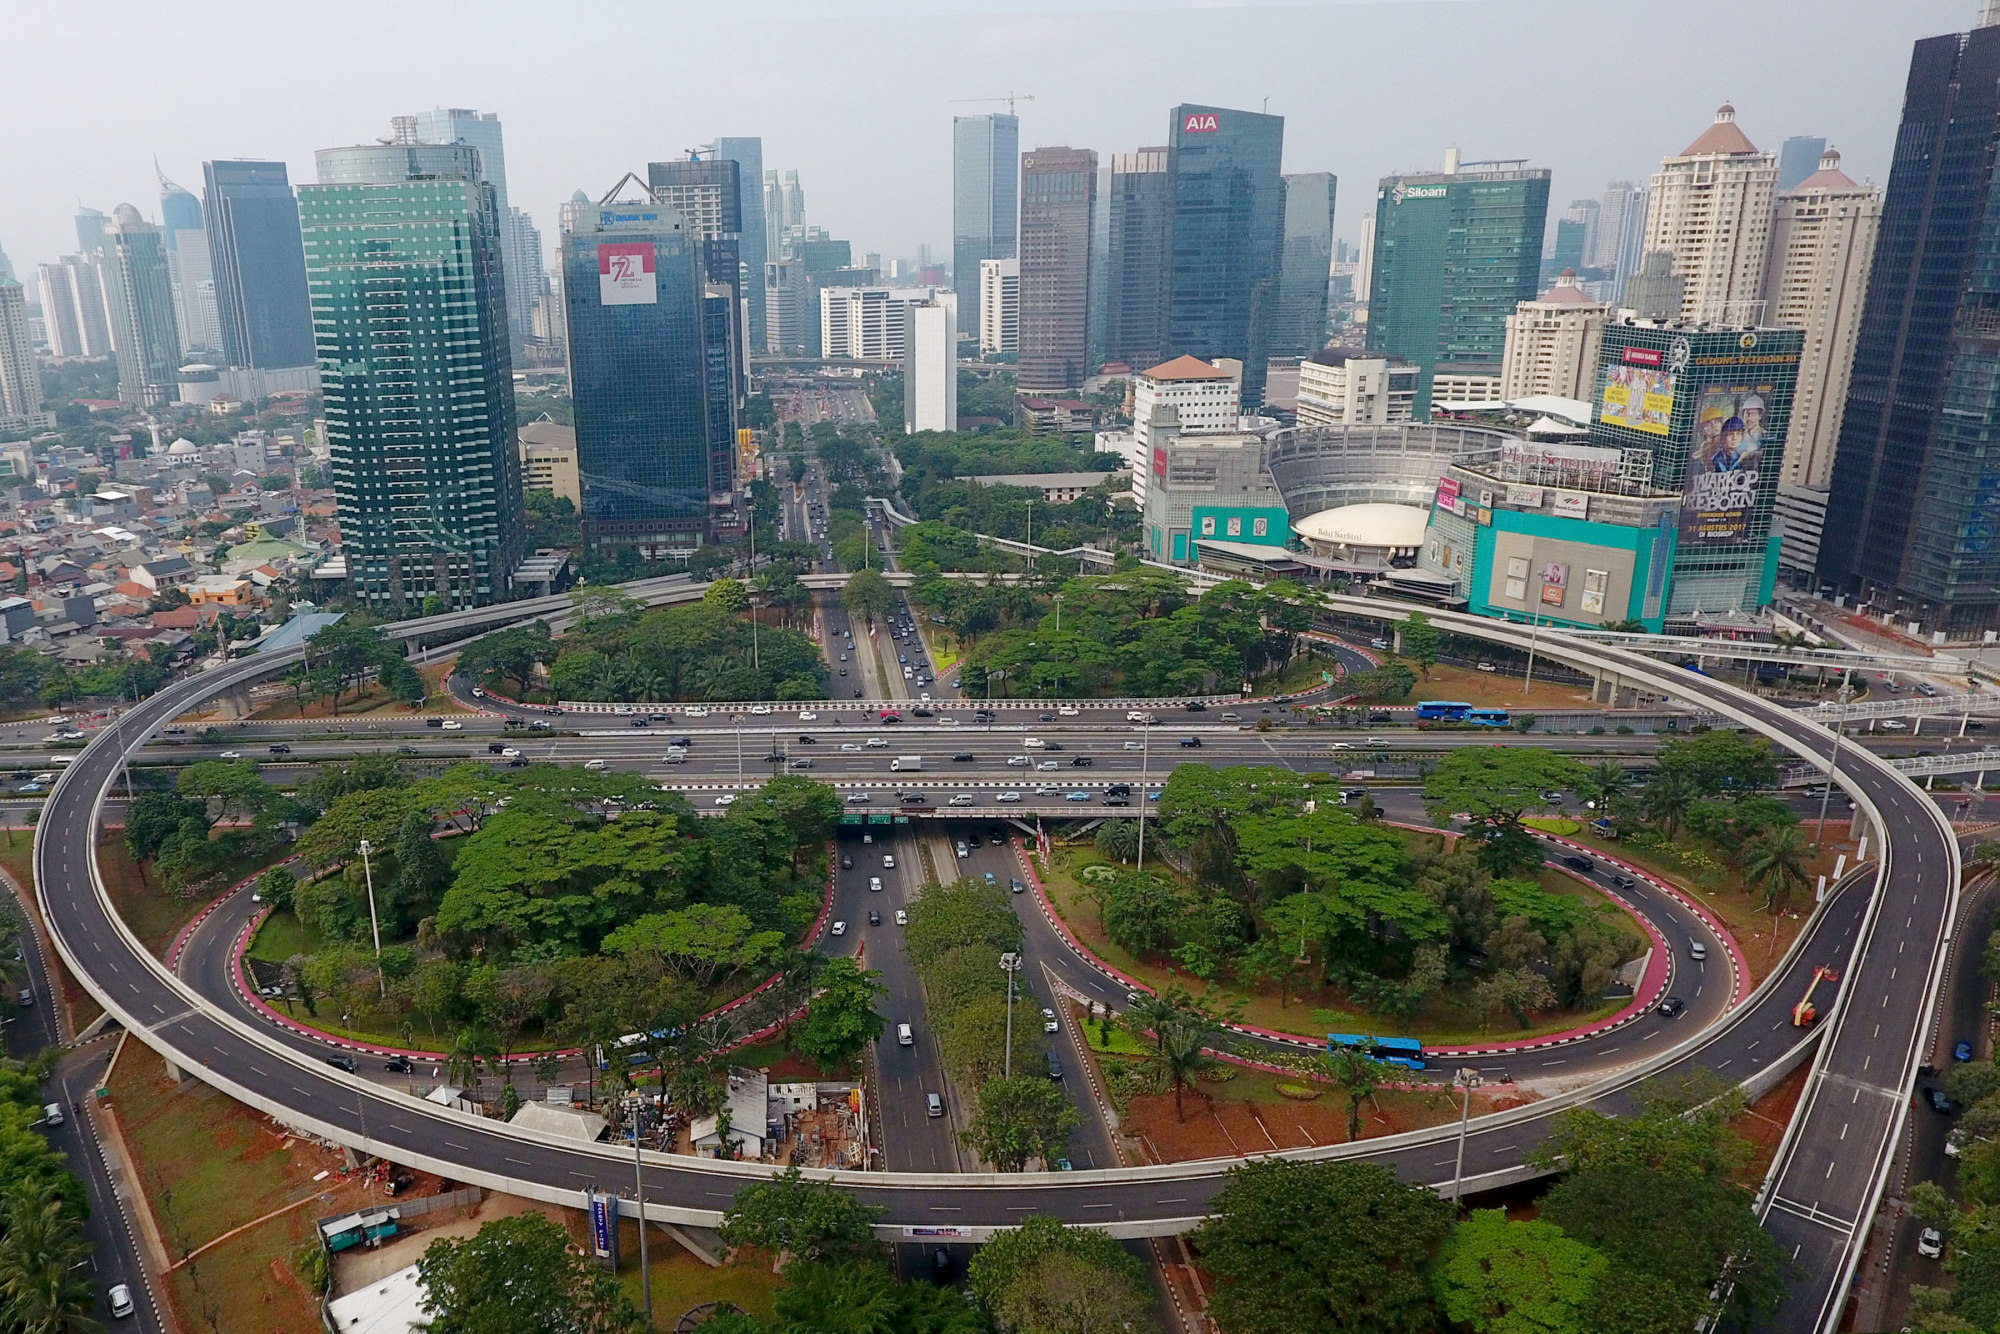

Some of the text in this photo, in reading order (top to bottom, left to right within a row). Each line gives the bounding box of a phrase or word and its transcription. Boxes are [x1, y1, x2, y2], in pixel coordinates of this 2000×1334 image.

[1186, 116, 1217, 130] AIA
[1407, 187, 1447, 198] Siloam
[611, 255, 635, 282] 72
[1501, 446, 1545, 464] Plaza
[1693, 469, 1758, 492] WARKOP
[1686, 490, 1757, 511] REBORN
[1699, 524, 1727, 532] AGUSTUS
[1729, 523, 1746, 531] 2017
